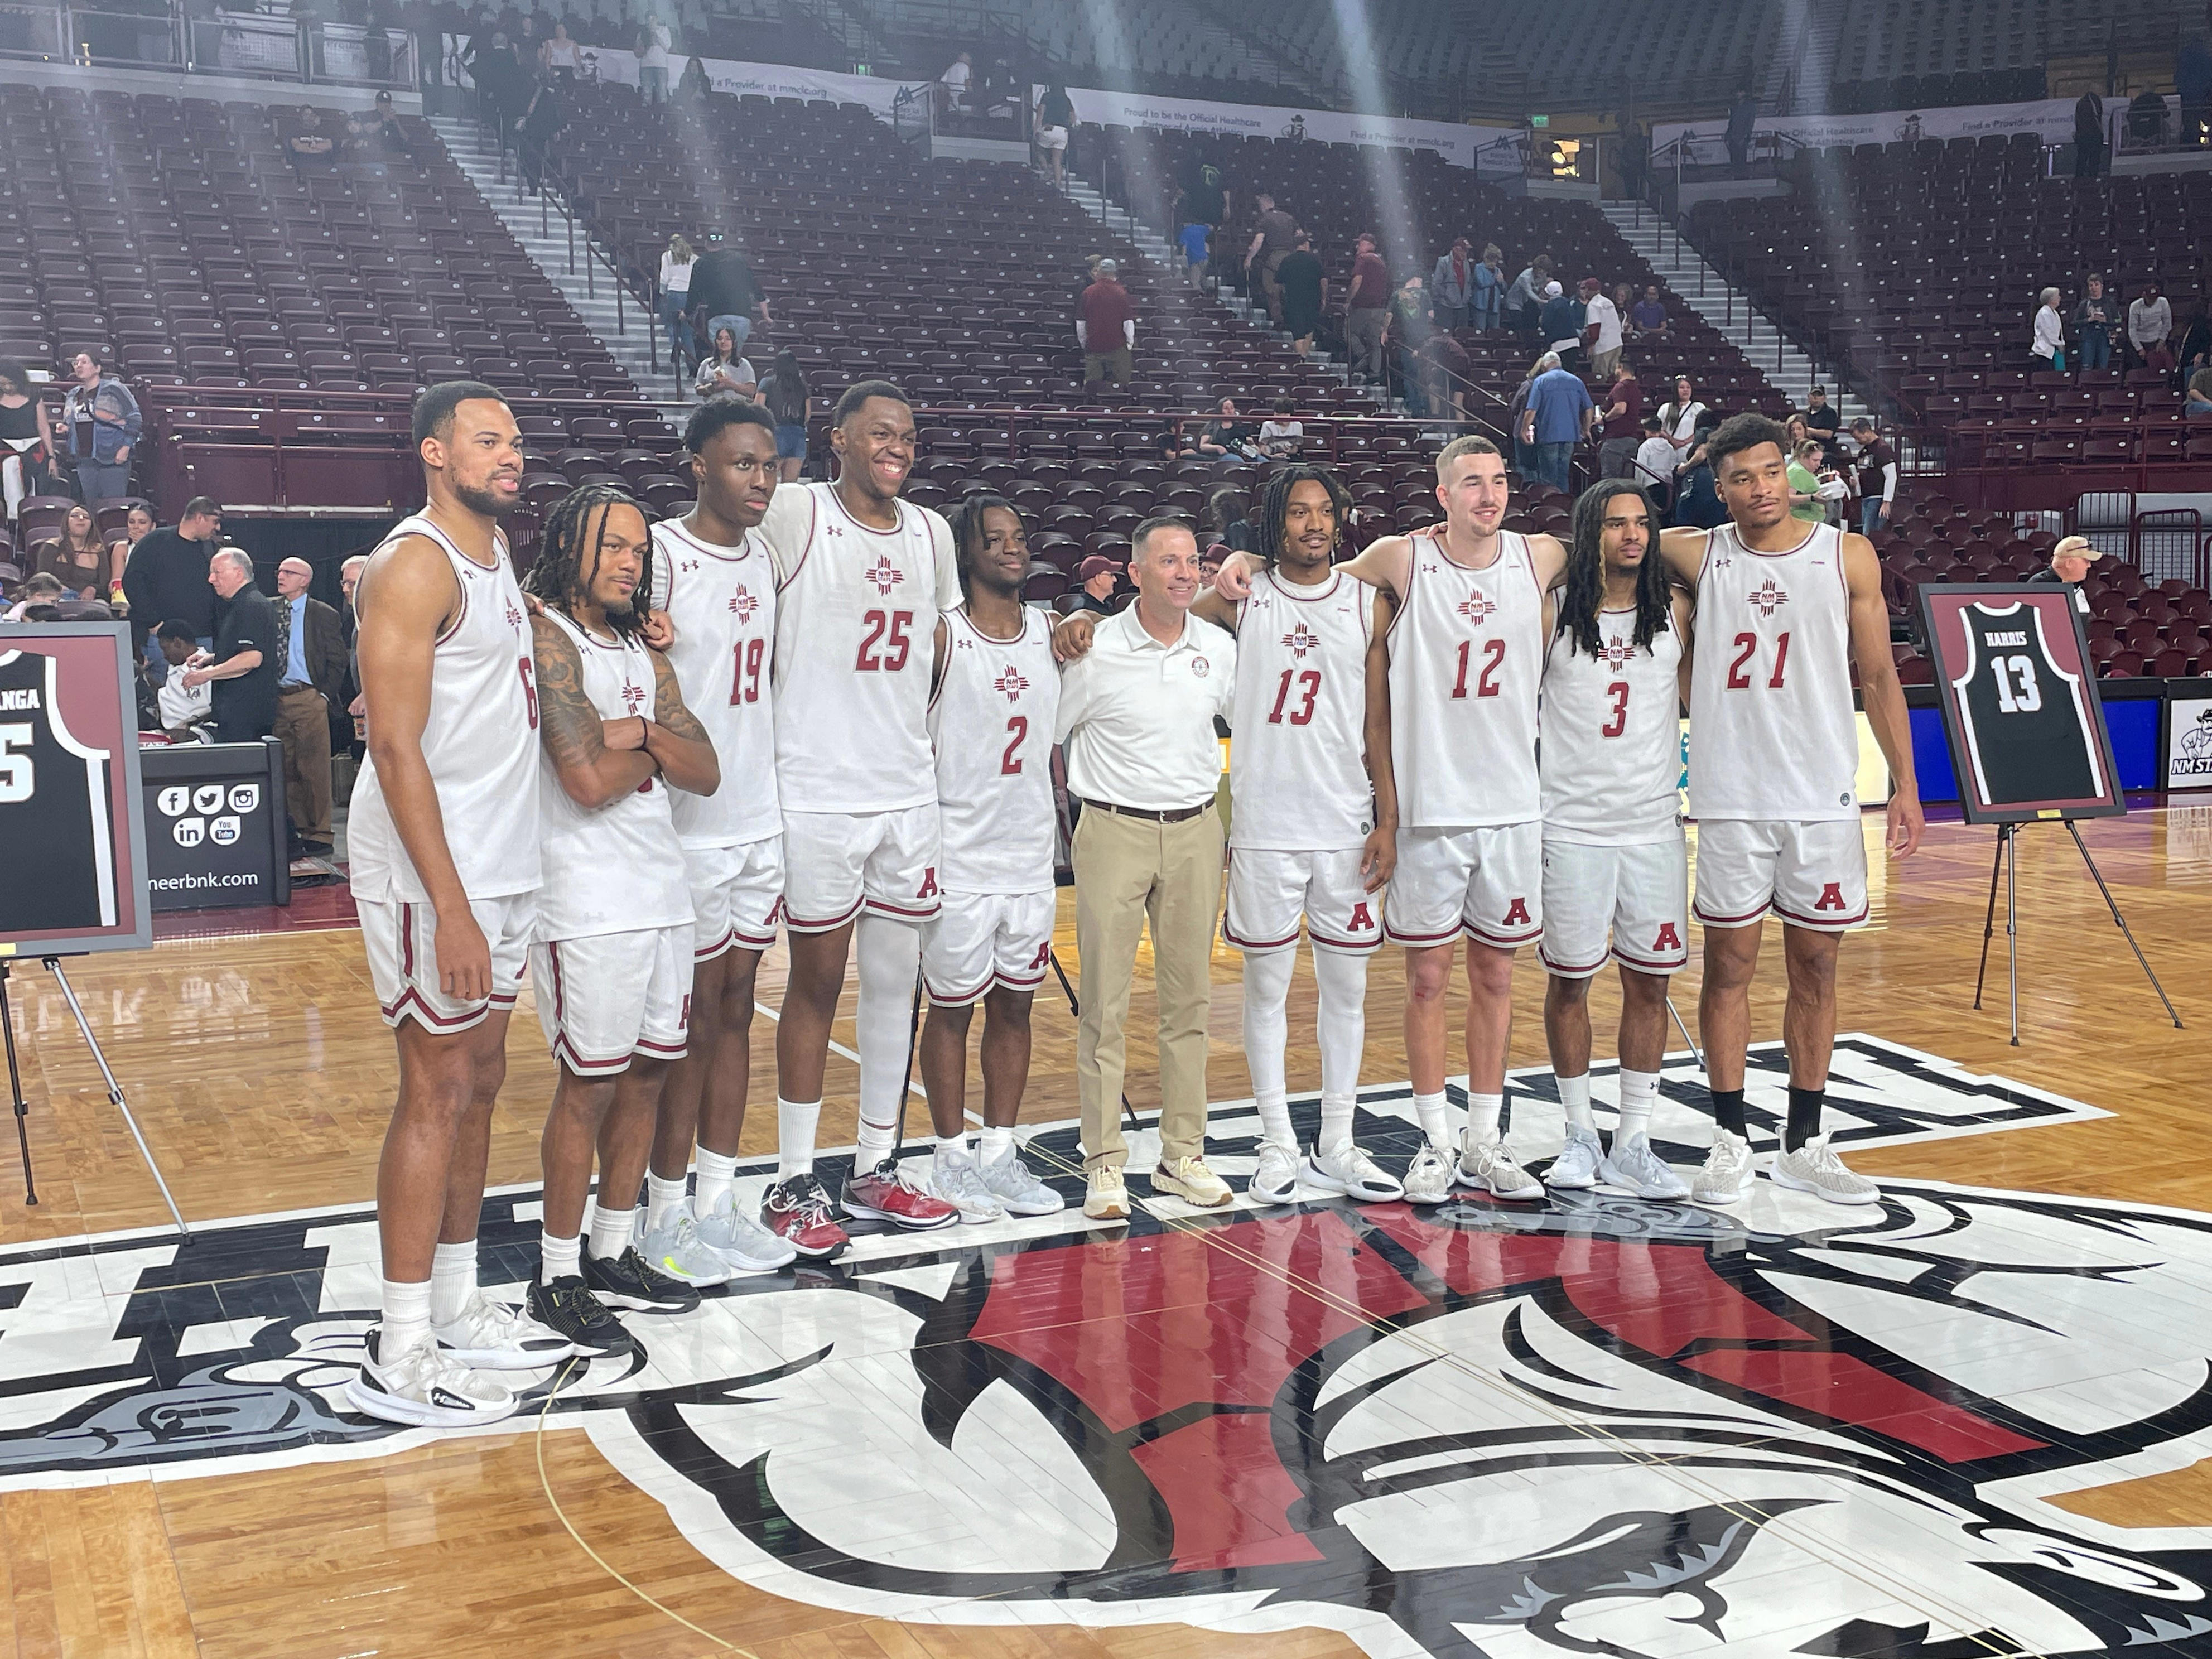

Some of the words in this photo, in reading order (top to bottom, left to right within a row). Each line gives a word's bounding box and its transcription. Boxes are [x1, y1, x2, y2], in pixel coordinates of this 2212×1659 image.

[725, 78, 764, 90] Provider
[1124, 108, 1149, 118] Proud
[1150, 110, 1159, 118] to
[1162, 111, 1172, 120] be
[1174, 112, 1187, 121] the
[1189, 113, 1217, 124] Official
[1220, 115, 1261, 127] Healthcare
[1792, 128, 1823, 137] Official
[1826, 127, 1874, 135] Healthcare
[1962, 121, 1983, 131] Find
[1994, 117, 2032, 127] Provider
[1350, 130, 1367, 139] Find
[1375, 133, 1406, 143] Provider
[856, 610, 913, 672] 25
[1984, 631, 2028, 647] HARRIS
[729, 638, 765, 707] 19
[1451, 638, 1506, 699] 12
[1727, 631, 1790, 689] 21
[1268, 669, 1322, 727] 13
[1990, 655, 2042, 713] 13
[0, 689, 40, 710] NGA
[1601, 681, 1630, 739] 3
[1000, 716, 1028, 777] 2
[2171, 759, 2195, 775] NM
[179, 824, 199, 842] in
[148, 872, 258, 891] neerbnk.com
[916, 867, 938, 899] A
[1814, 881, 1847, 911] A
[1346, 901, 1375, 932] A
[1502, 897, 1531, 925] A
[1652, 922, 1681, 952] A
[1029, 941, 1049, 970] A
